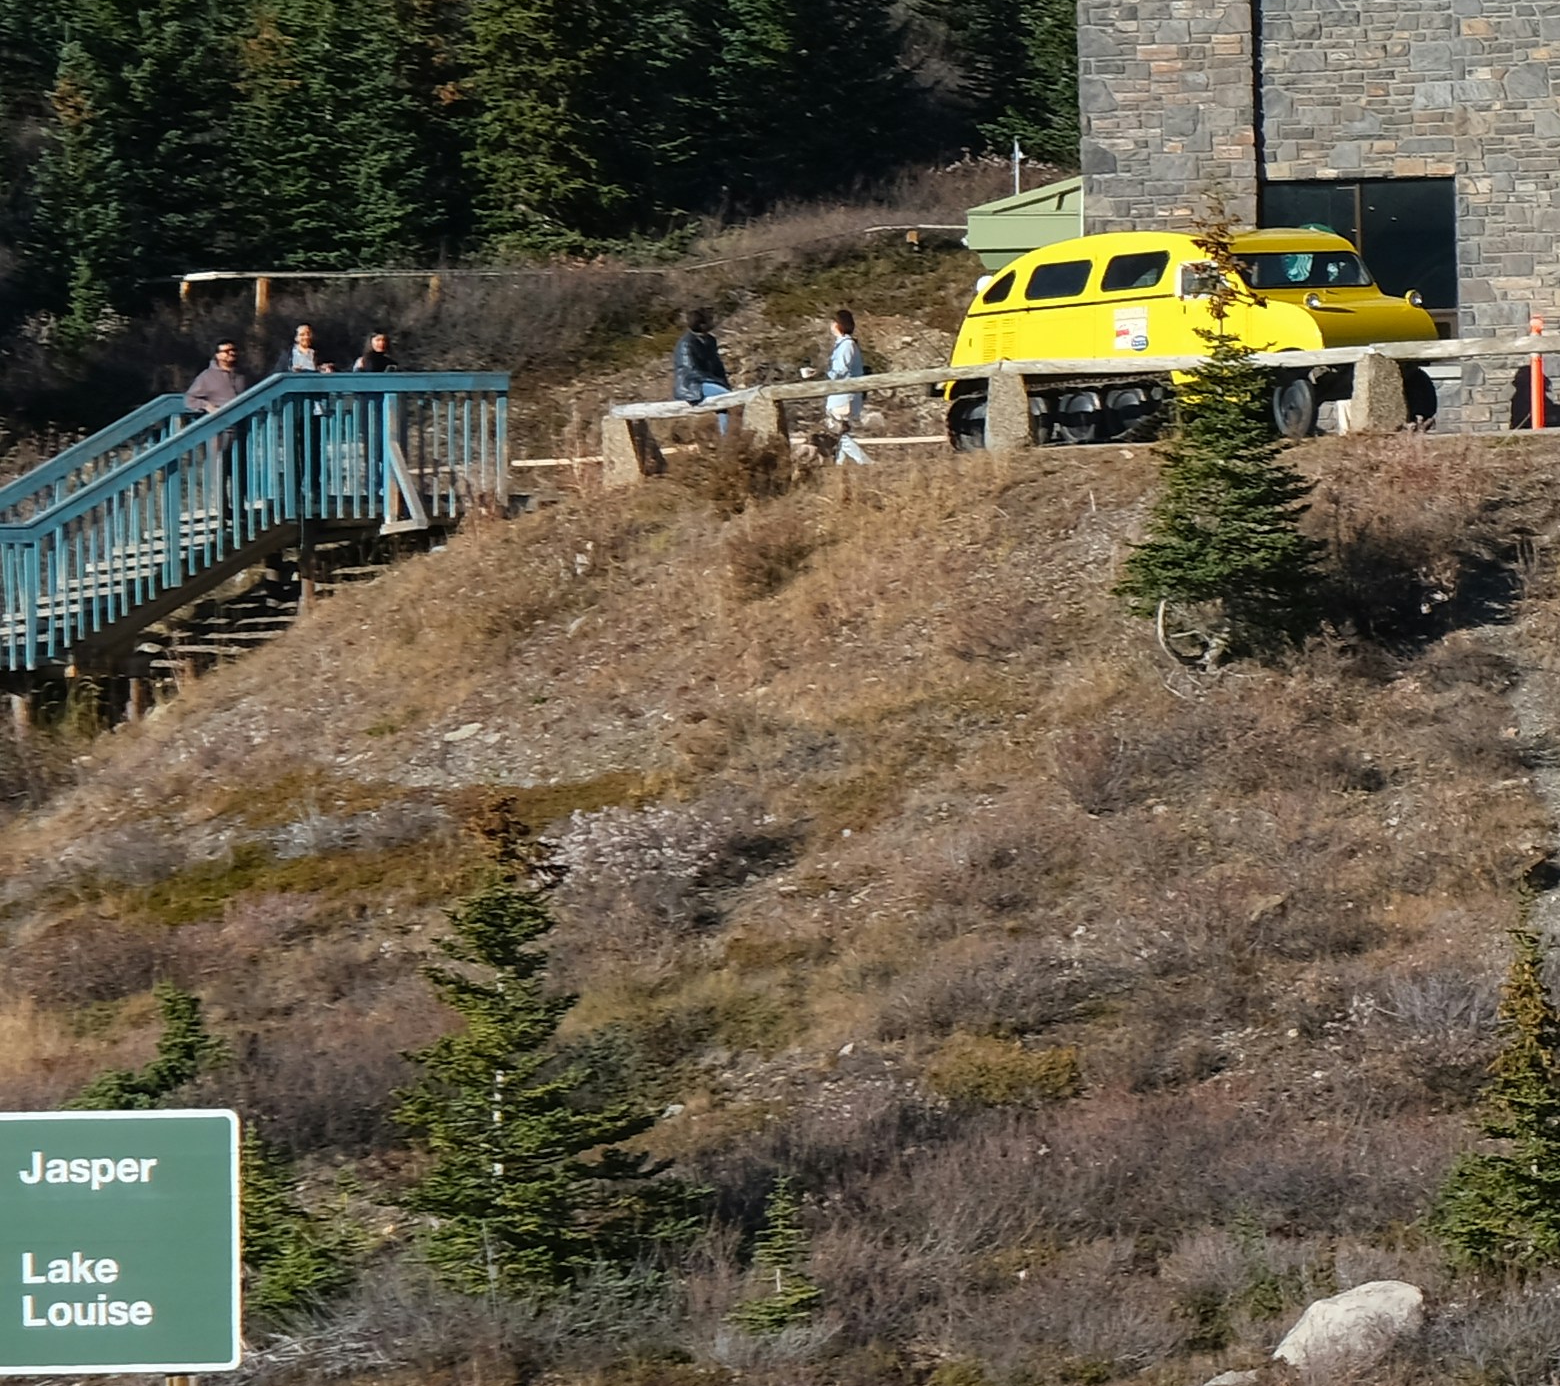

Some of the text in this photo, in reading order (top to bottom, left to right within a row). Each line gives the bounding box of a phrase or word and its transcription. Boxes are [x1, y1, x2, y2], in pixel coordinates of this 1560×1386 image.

[18, 1151, 157, 1190] Jasper
[22, 1251, 119, 1284] Lake
[22, 1294, 153, 1327] Louise
